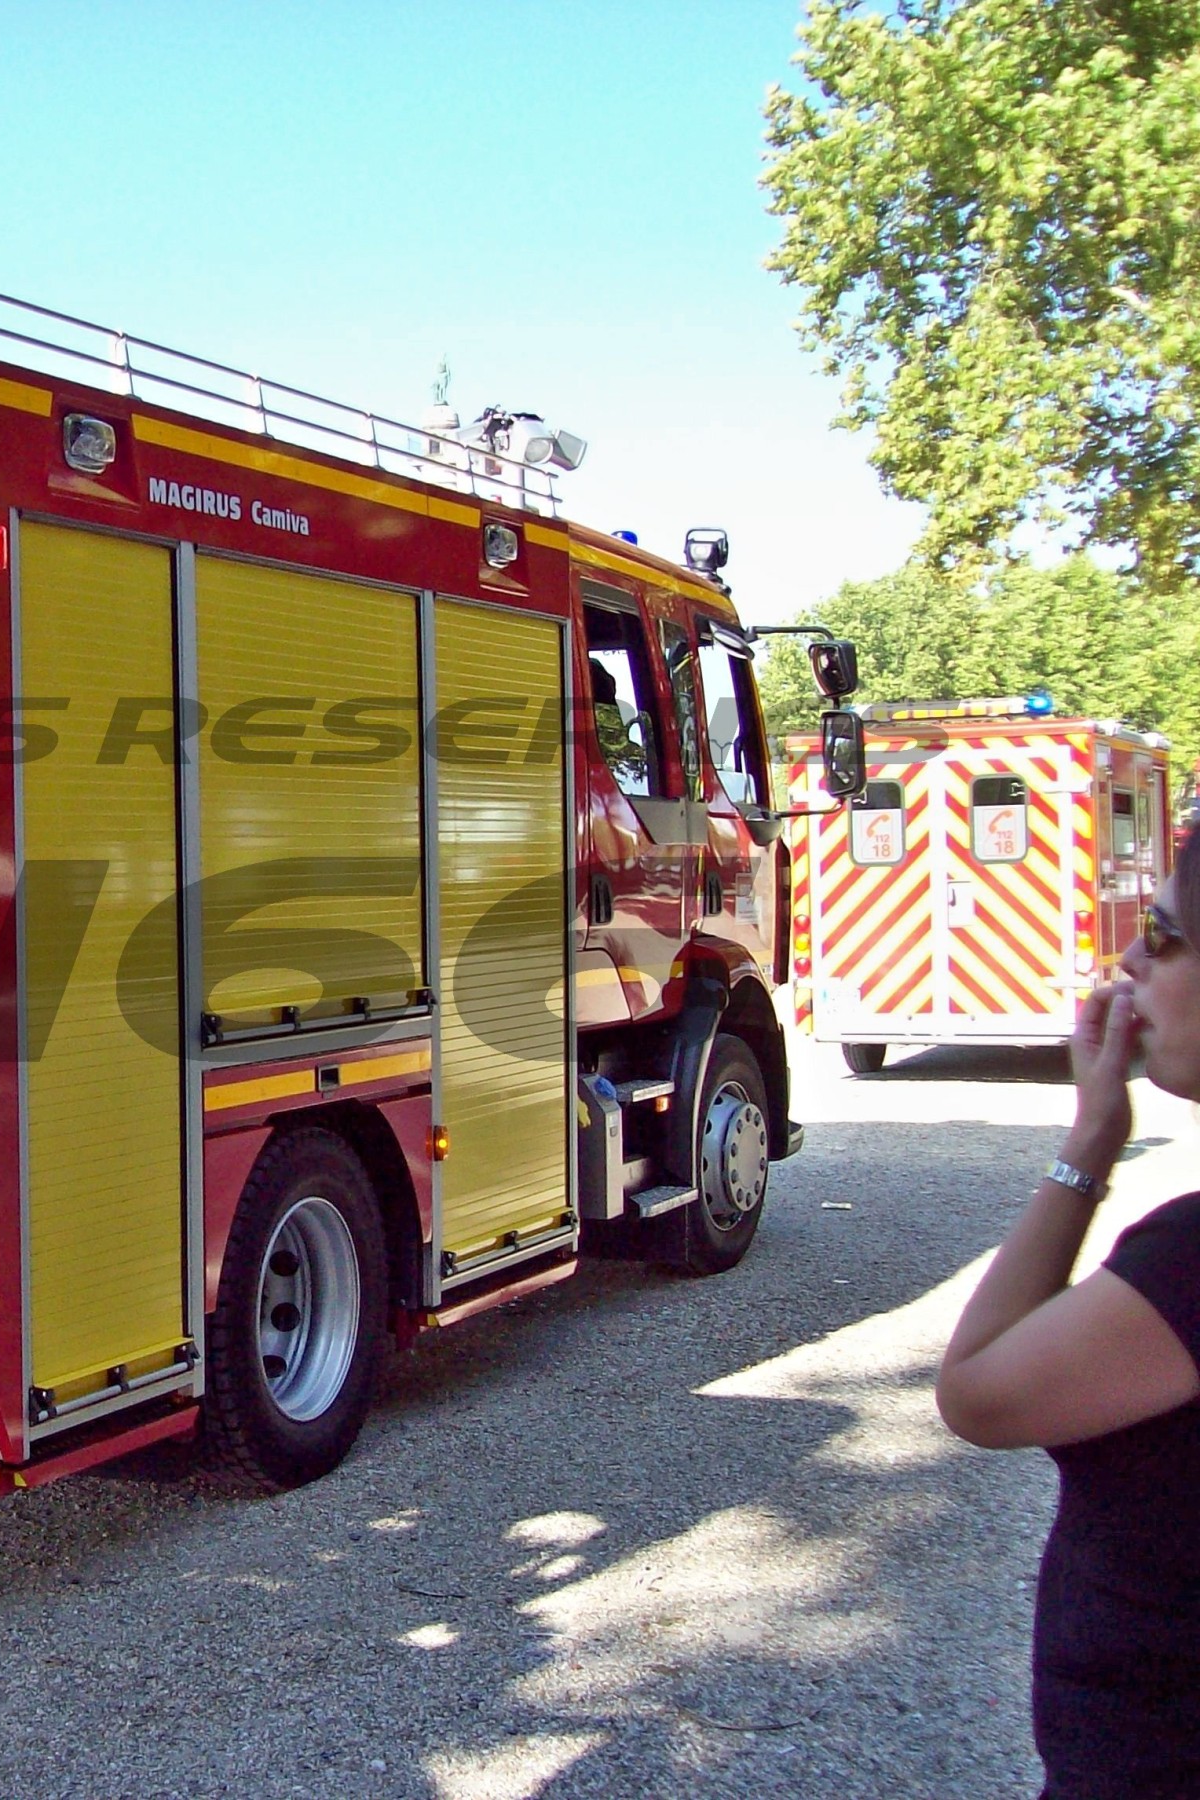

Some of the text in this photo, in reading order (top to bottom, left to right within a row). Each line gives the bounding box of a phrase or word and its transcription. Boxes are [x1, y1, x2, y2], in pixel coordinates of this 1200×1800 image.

[148, 476, 310, 536] MAGIRUS Camiva
[874, 834, 891, 844] 112
[996, 830, 1013, 840] 112
[872, 844, 892, 858] 18
[994, 840, 1015, 855] 18
